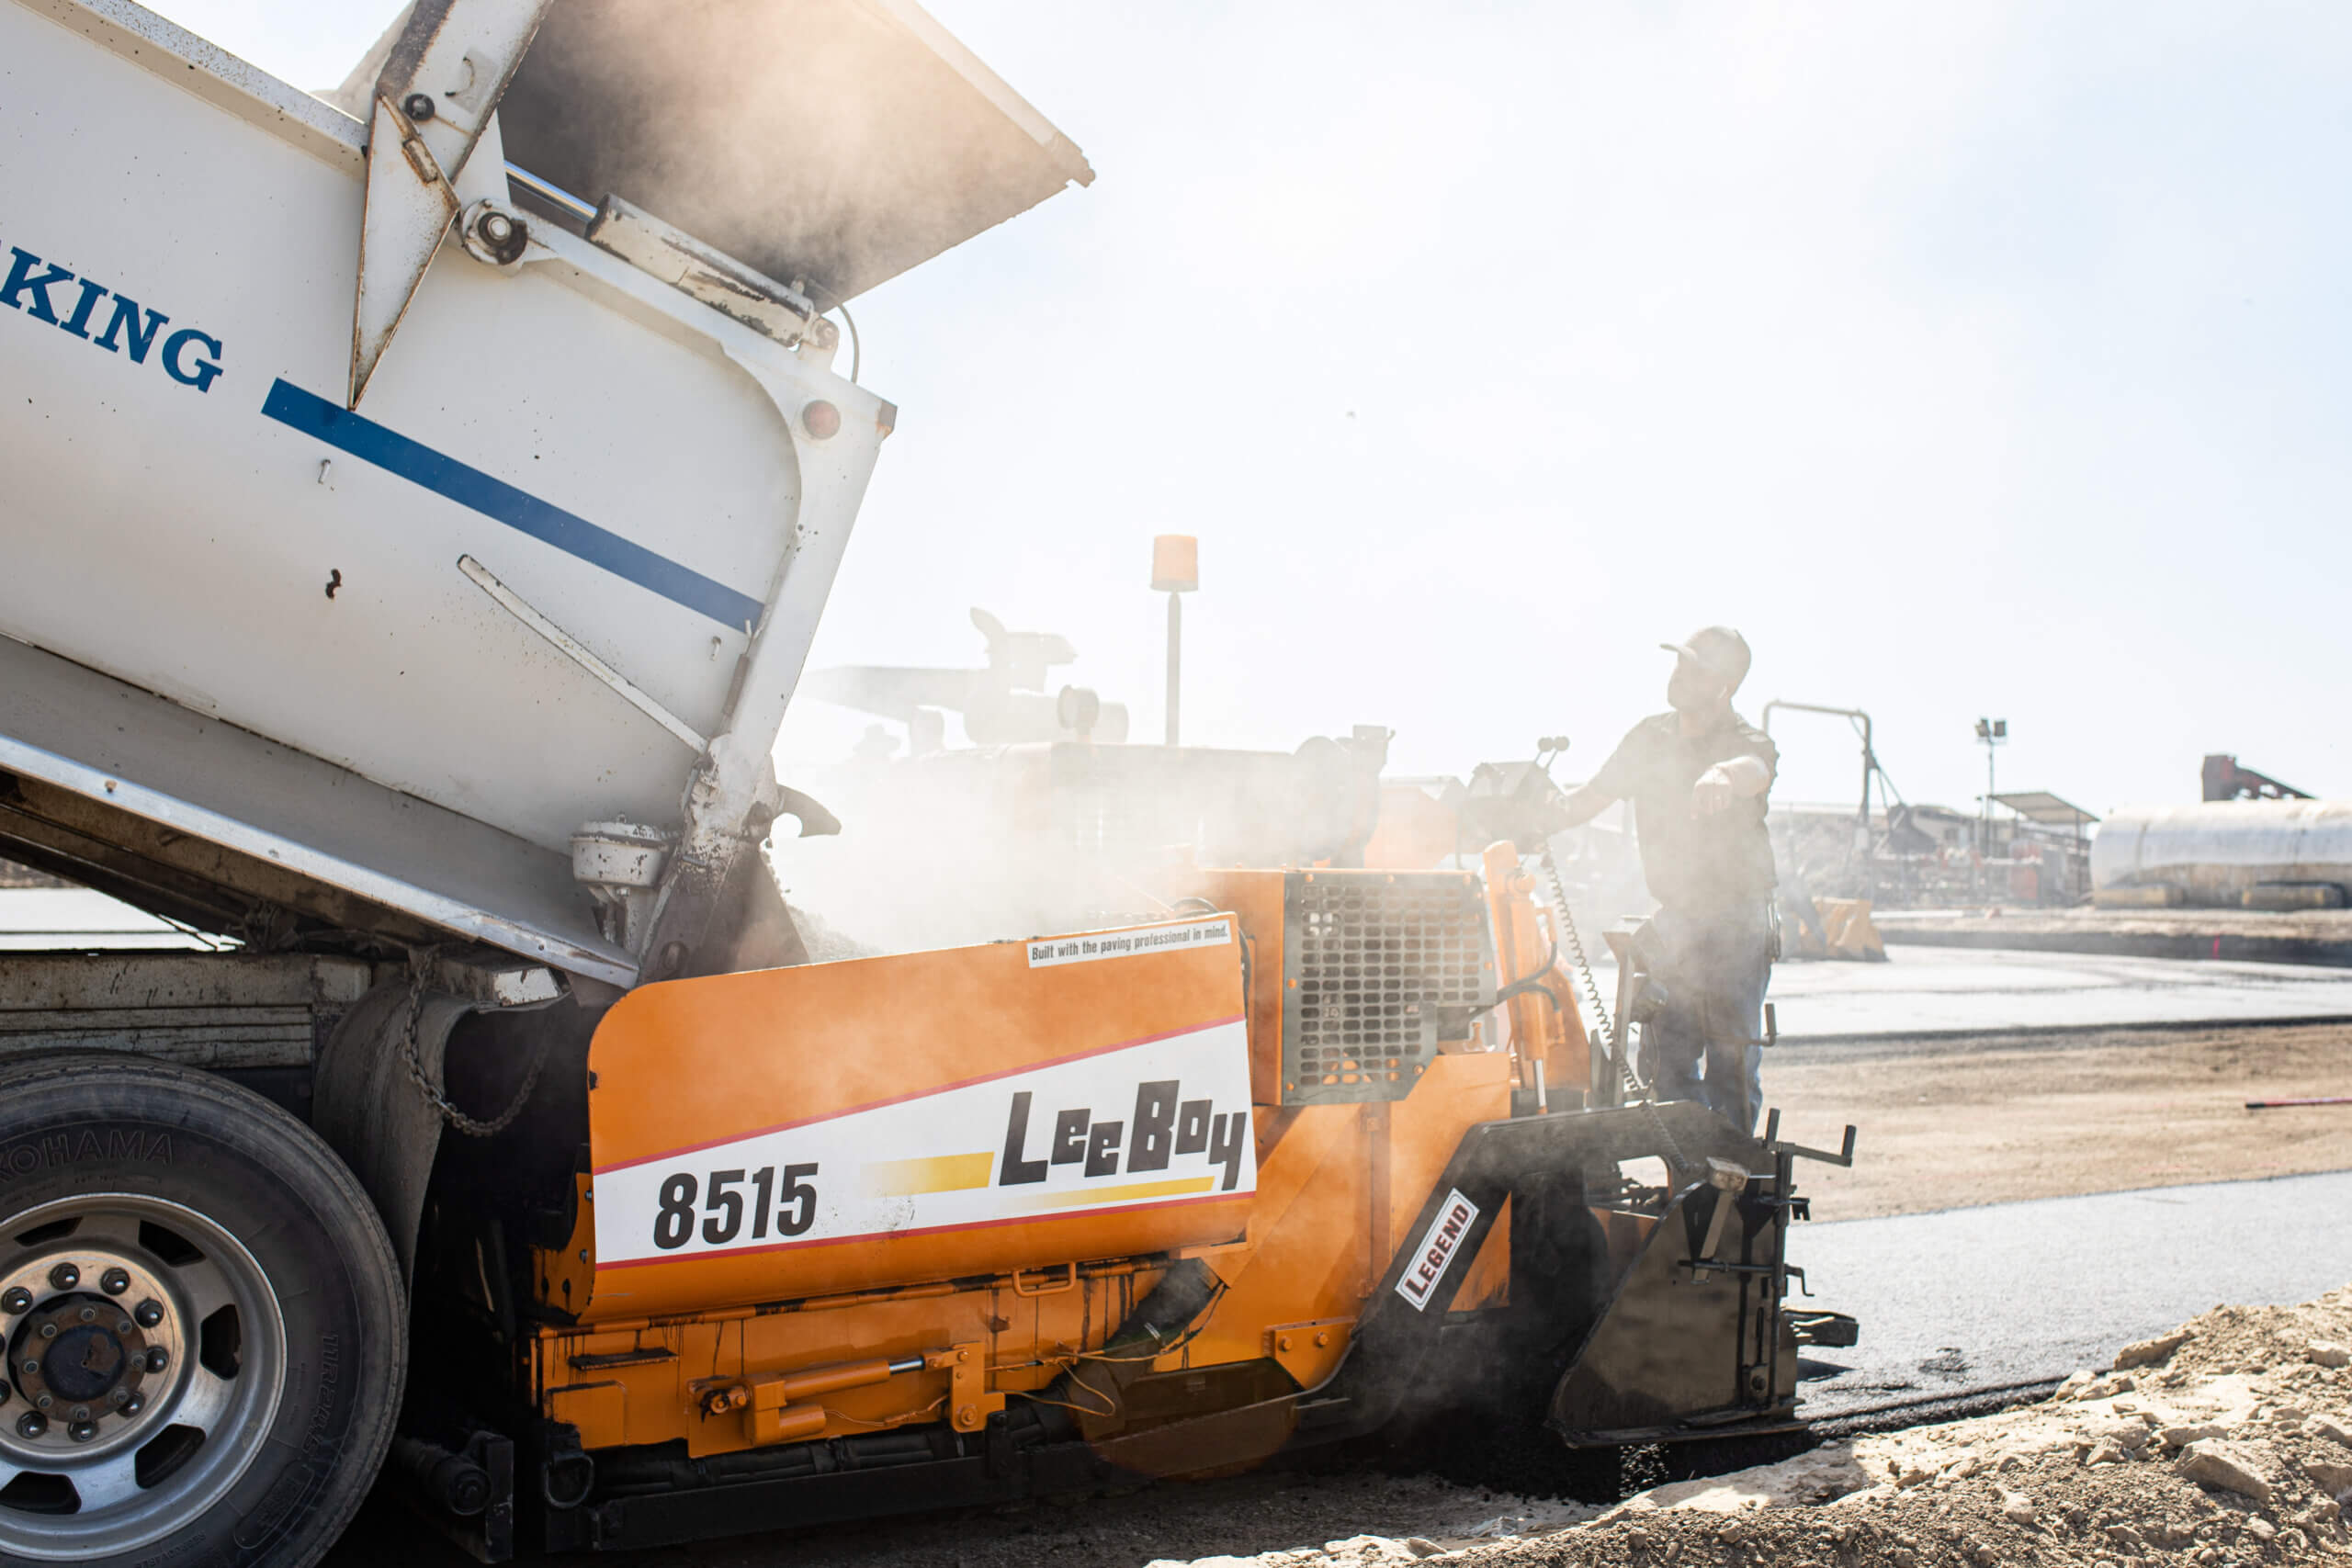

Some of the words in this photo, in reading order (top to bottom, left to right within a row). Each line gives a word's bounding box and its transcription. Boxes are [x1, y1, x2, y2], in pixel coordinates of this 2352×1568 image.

[0, 245, 224, 394] KING
[1032, 945, 1054, 961] Built
[1057, 942, 1079, 957] with
[1082, 940, 1097, 954] the
[1101, 936, 1131, 954] paving
[1134, 928, 1191, 950] professional
[1193, 928, 1202, 942] in
[1204, 924, 1228, 939] mind.
[999, 1079, 1248, 1191] LeeBoy
[653, 1161, 820, 1250] 8515
[1404, 1203, 1471, 1300] LEGEND
